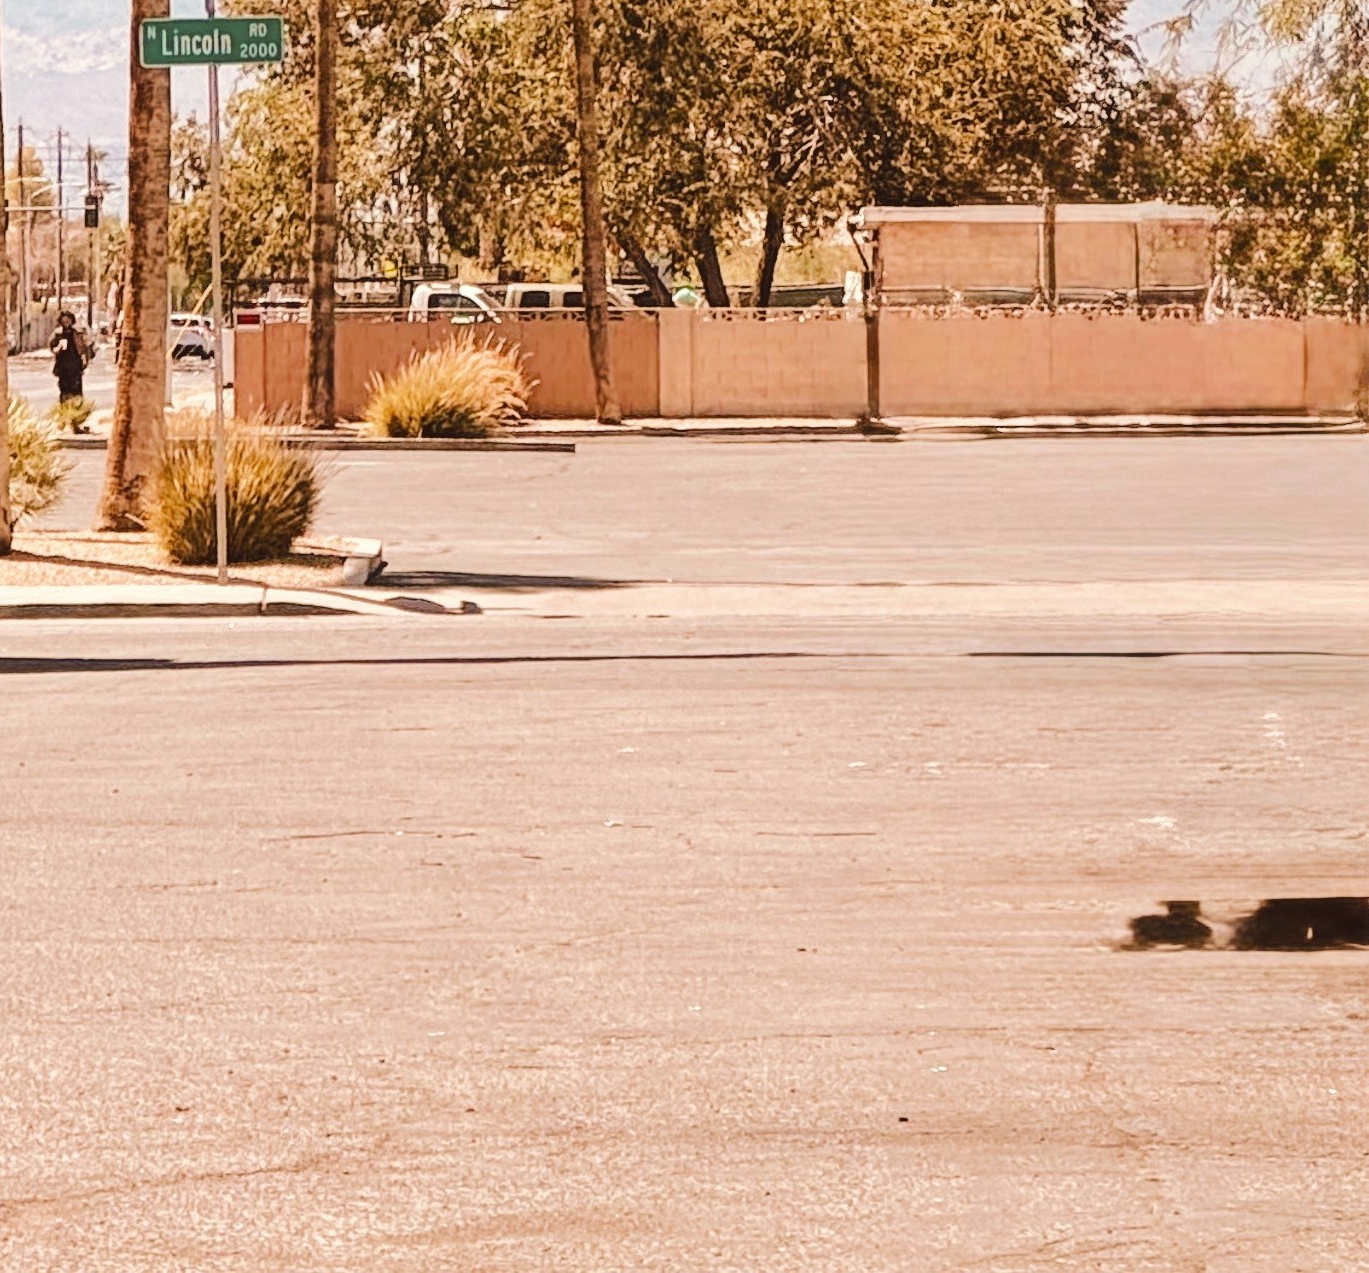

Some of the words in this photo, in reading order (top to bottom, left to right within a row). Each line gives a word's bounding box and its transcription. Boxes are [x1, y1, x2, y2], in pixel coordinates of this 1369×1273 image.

[147, 25, 157, 40] N
[161, 28, 231, 56] Lincoln
[248, 22, 268, 38] RD
[239, 42, 278, 59] 2000
